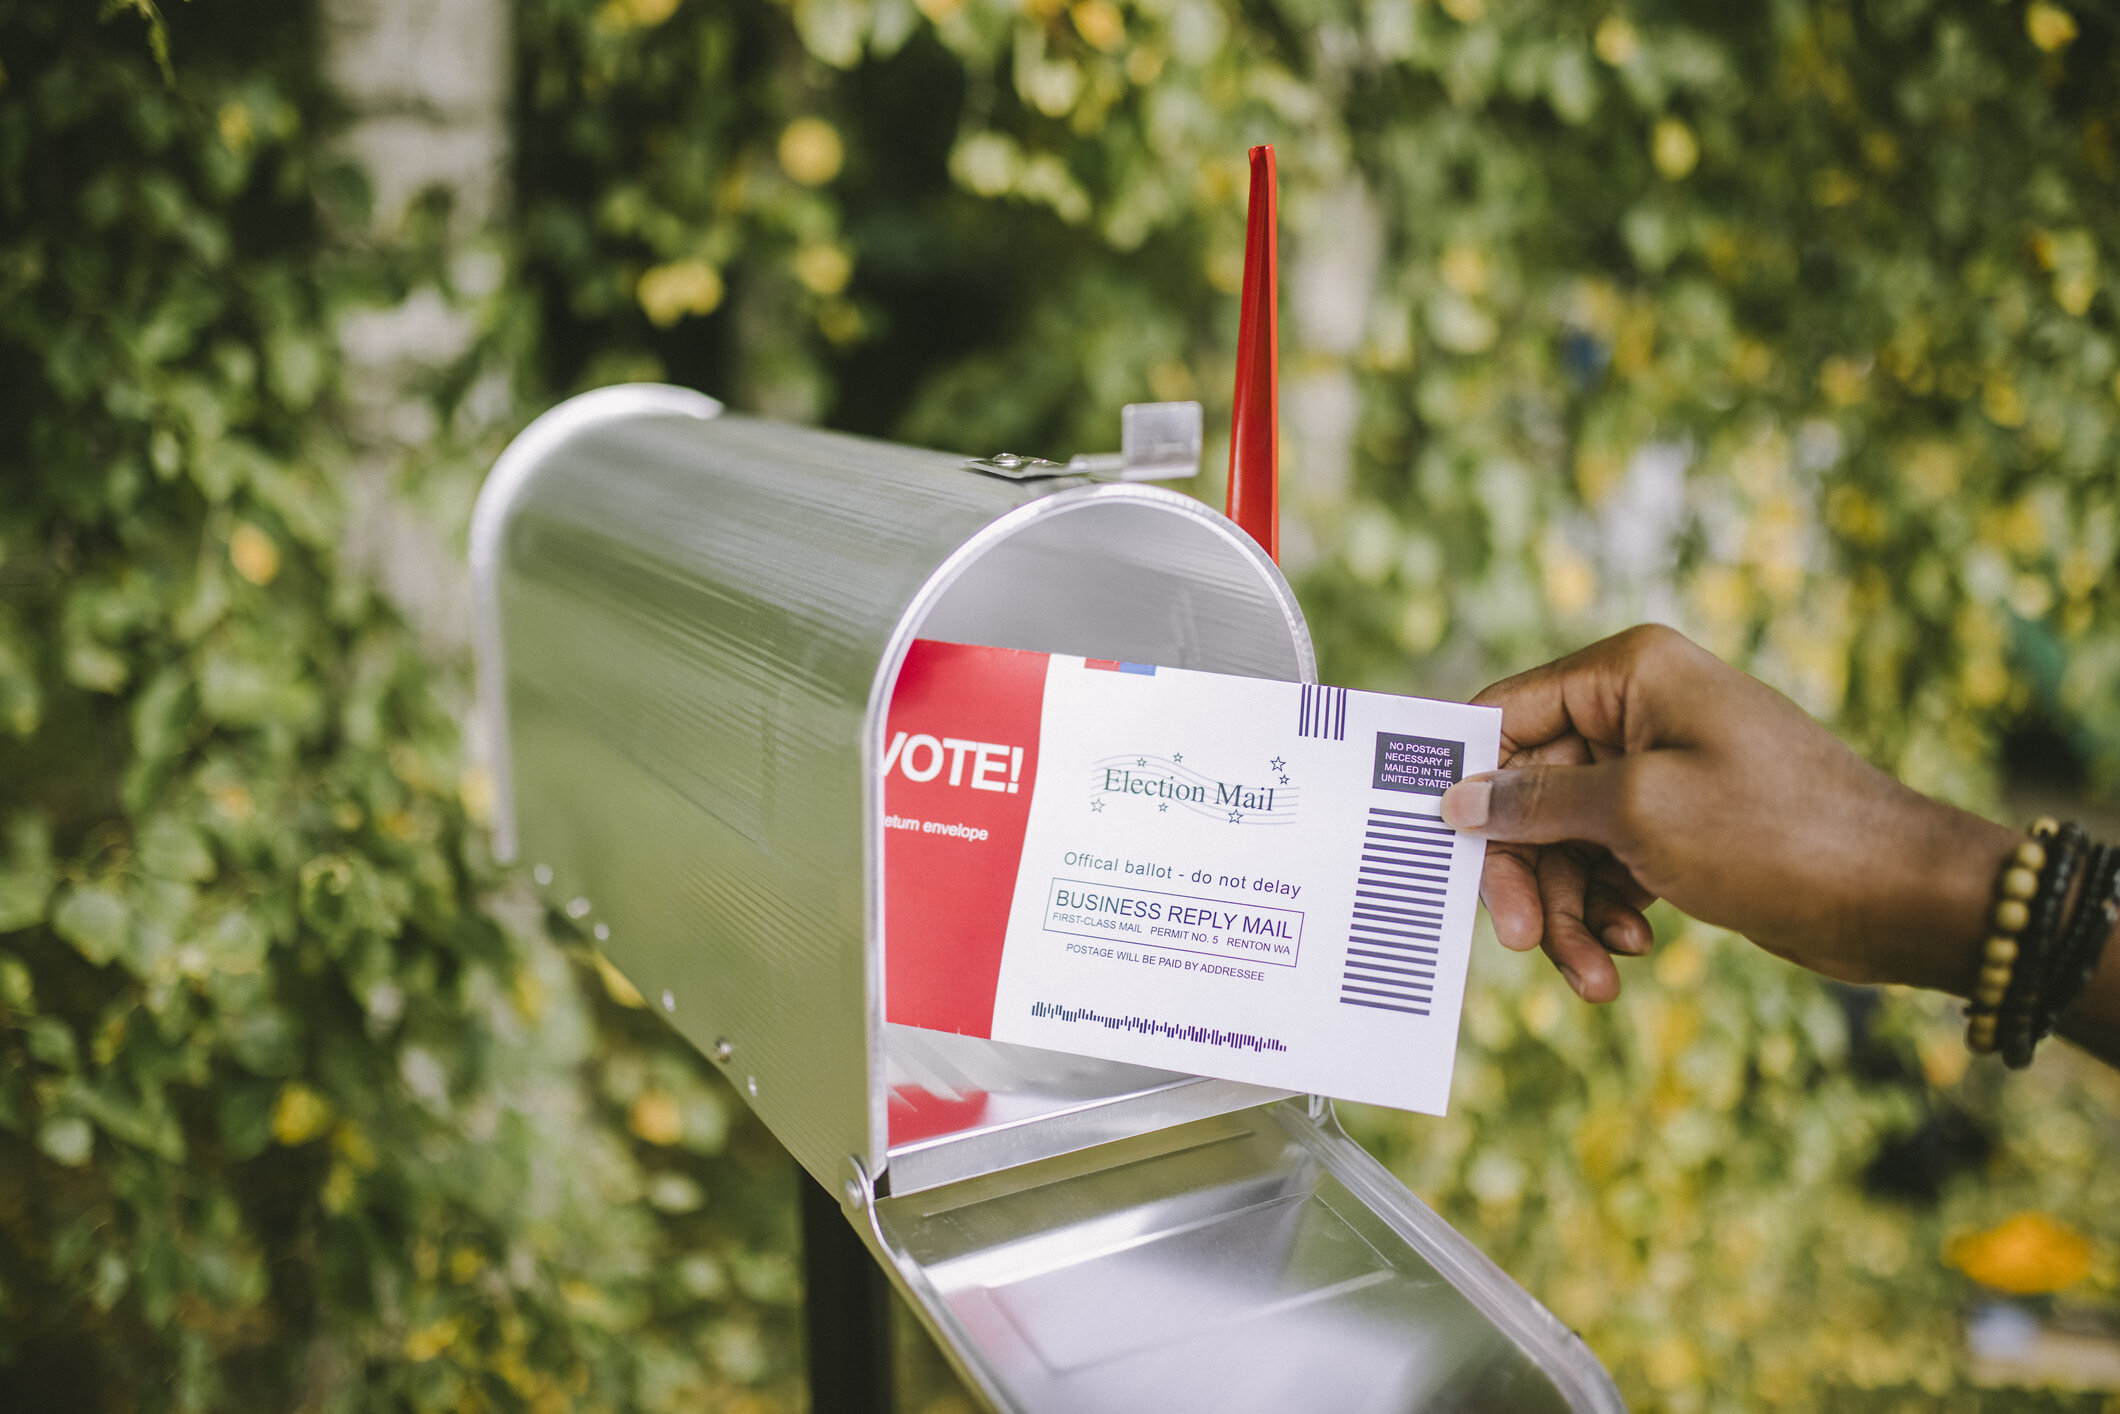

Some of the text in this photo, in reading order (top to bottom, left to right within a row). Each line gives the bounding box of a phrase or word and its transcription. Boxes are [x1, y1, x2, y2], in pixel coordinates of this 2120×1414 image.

[1385, 752, 1454, 768] NECESSARY IF
[1389, 741, 1451, 757] NO POSTAGE
[1381, 773, 1416, 785] UNITED
[1384, 763, 1452, 779] MAILED IN THE
[1103, 767, 1274, 811] Election Mail
[884, 814, 989, 842] eturn envelope
[1064, 851, 1119, 872] Offical
[1124, 860, 1173, 879] ballot
[1191, 869, 1212, 885] do
[1219, 875, 1247, 889] not
[1253, 877, 1302, 899] delay
[1056, 889, 1293, 940] BUSINESS REPLY MAIL
[1052, 912, 1291, 955] FIRST-CLASS MAIL PERMIT NO. 5 RENTON WA
[1066, 943, 1265, 981] POSTAGE WILL BE PAID BY ADDRESSEE
